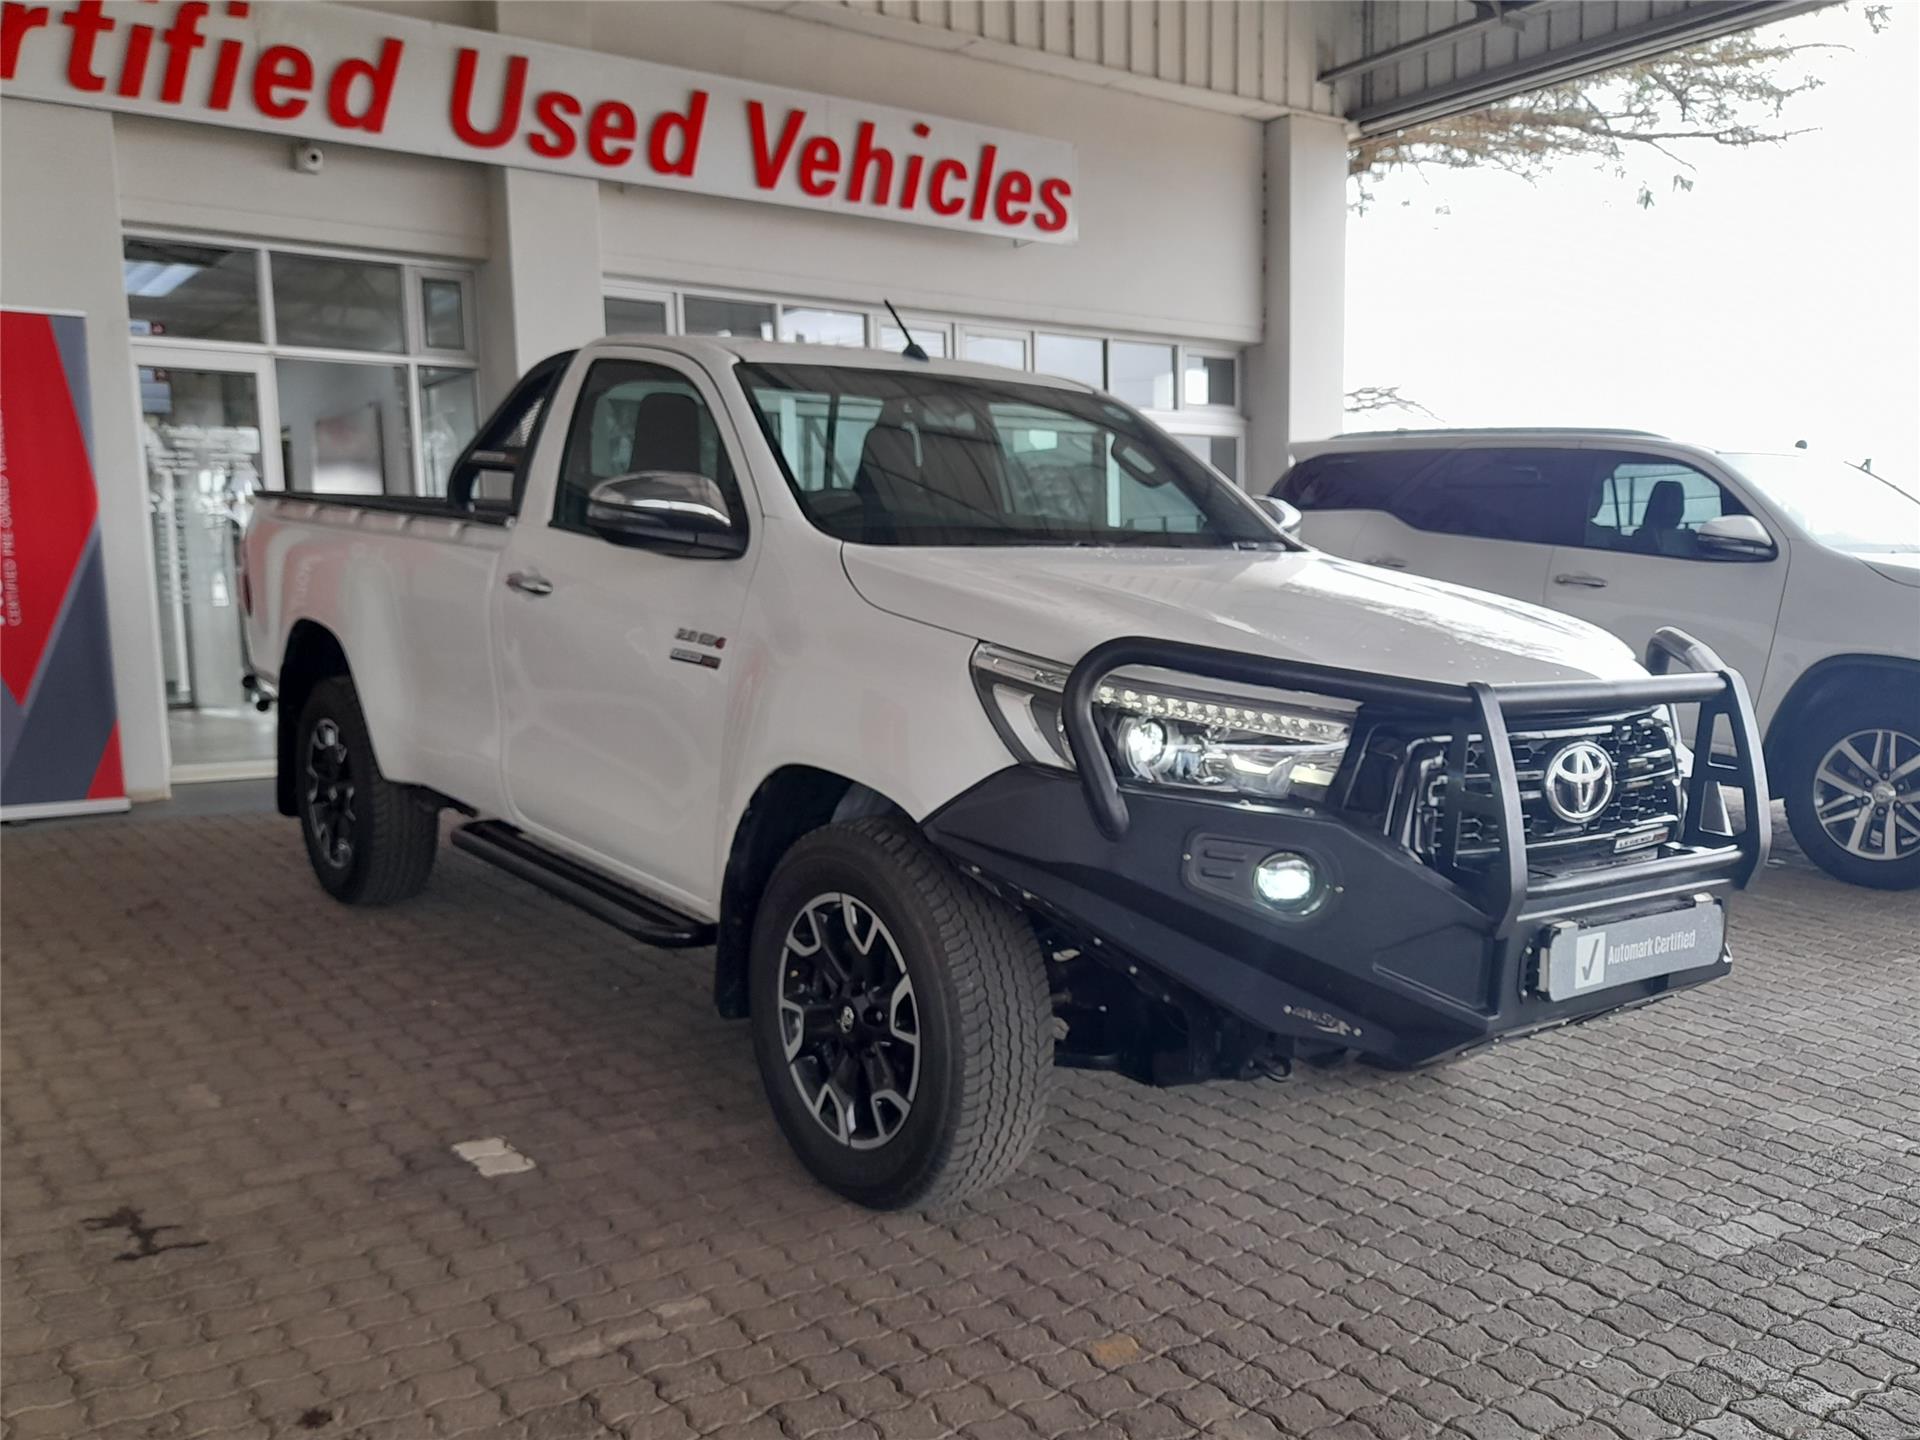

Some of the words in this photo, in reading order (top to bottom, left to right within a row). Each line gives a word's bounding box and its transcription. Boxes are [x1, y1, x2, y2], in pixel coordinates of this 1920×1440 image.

[450, 49, 708, 177] Used
[747, 100, 1071, 232] Vehicles
[1608, 938, 1654, 965] Automark
[1655, 929, 1696, 955] Certified
